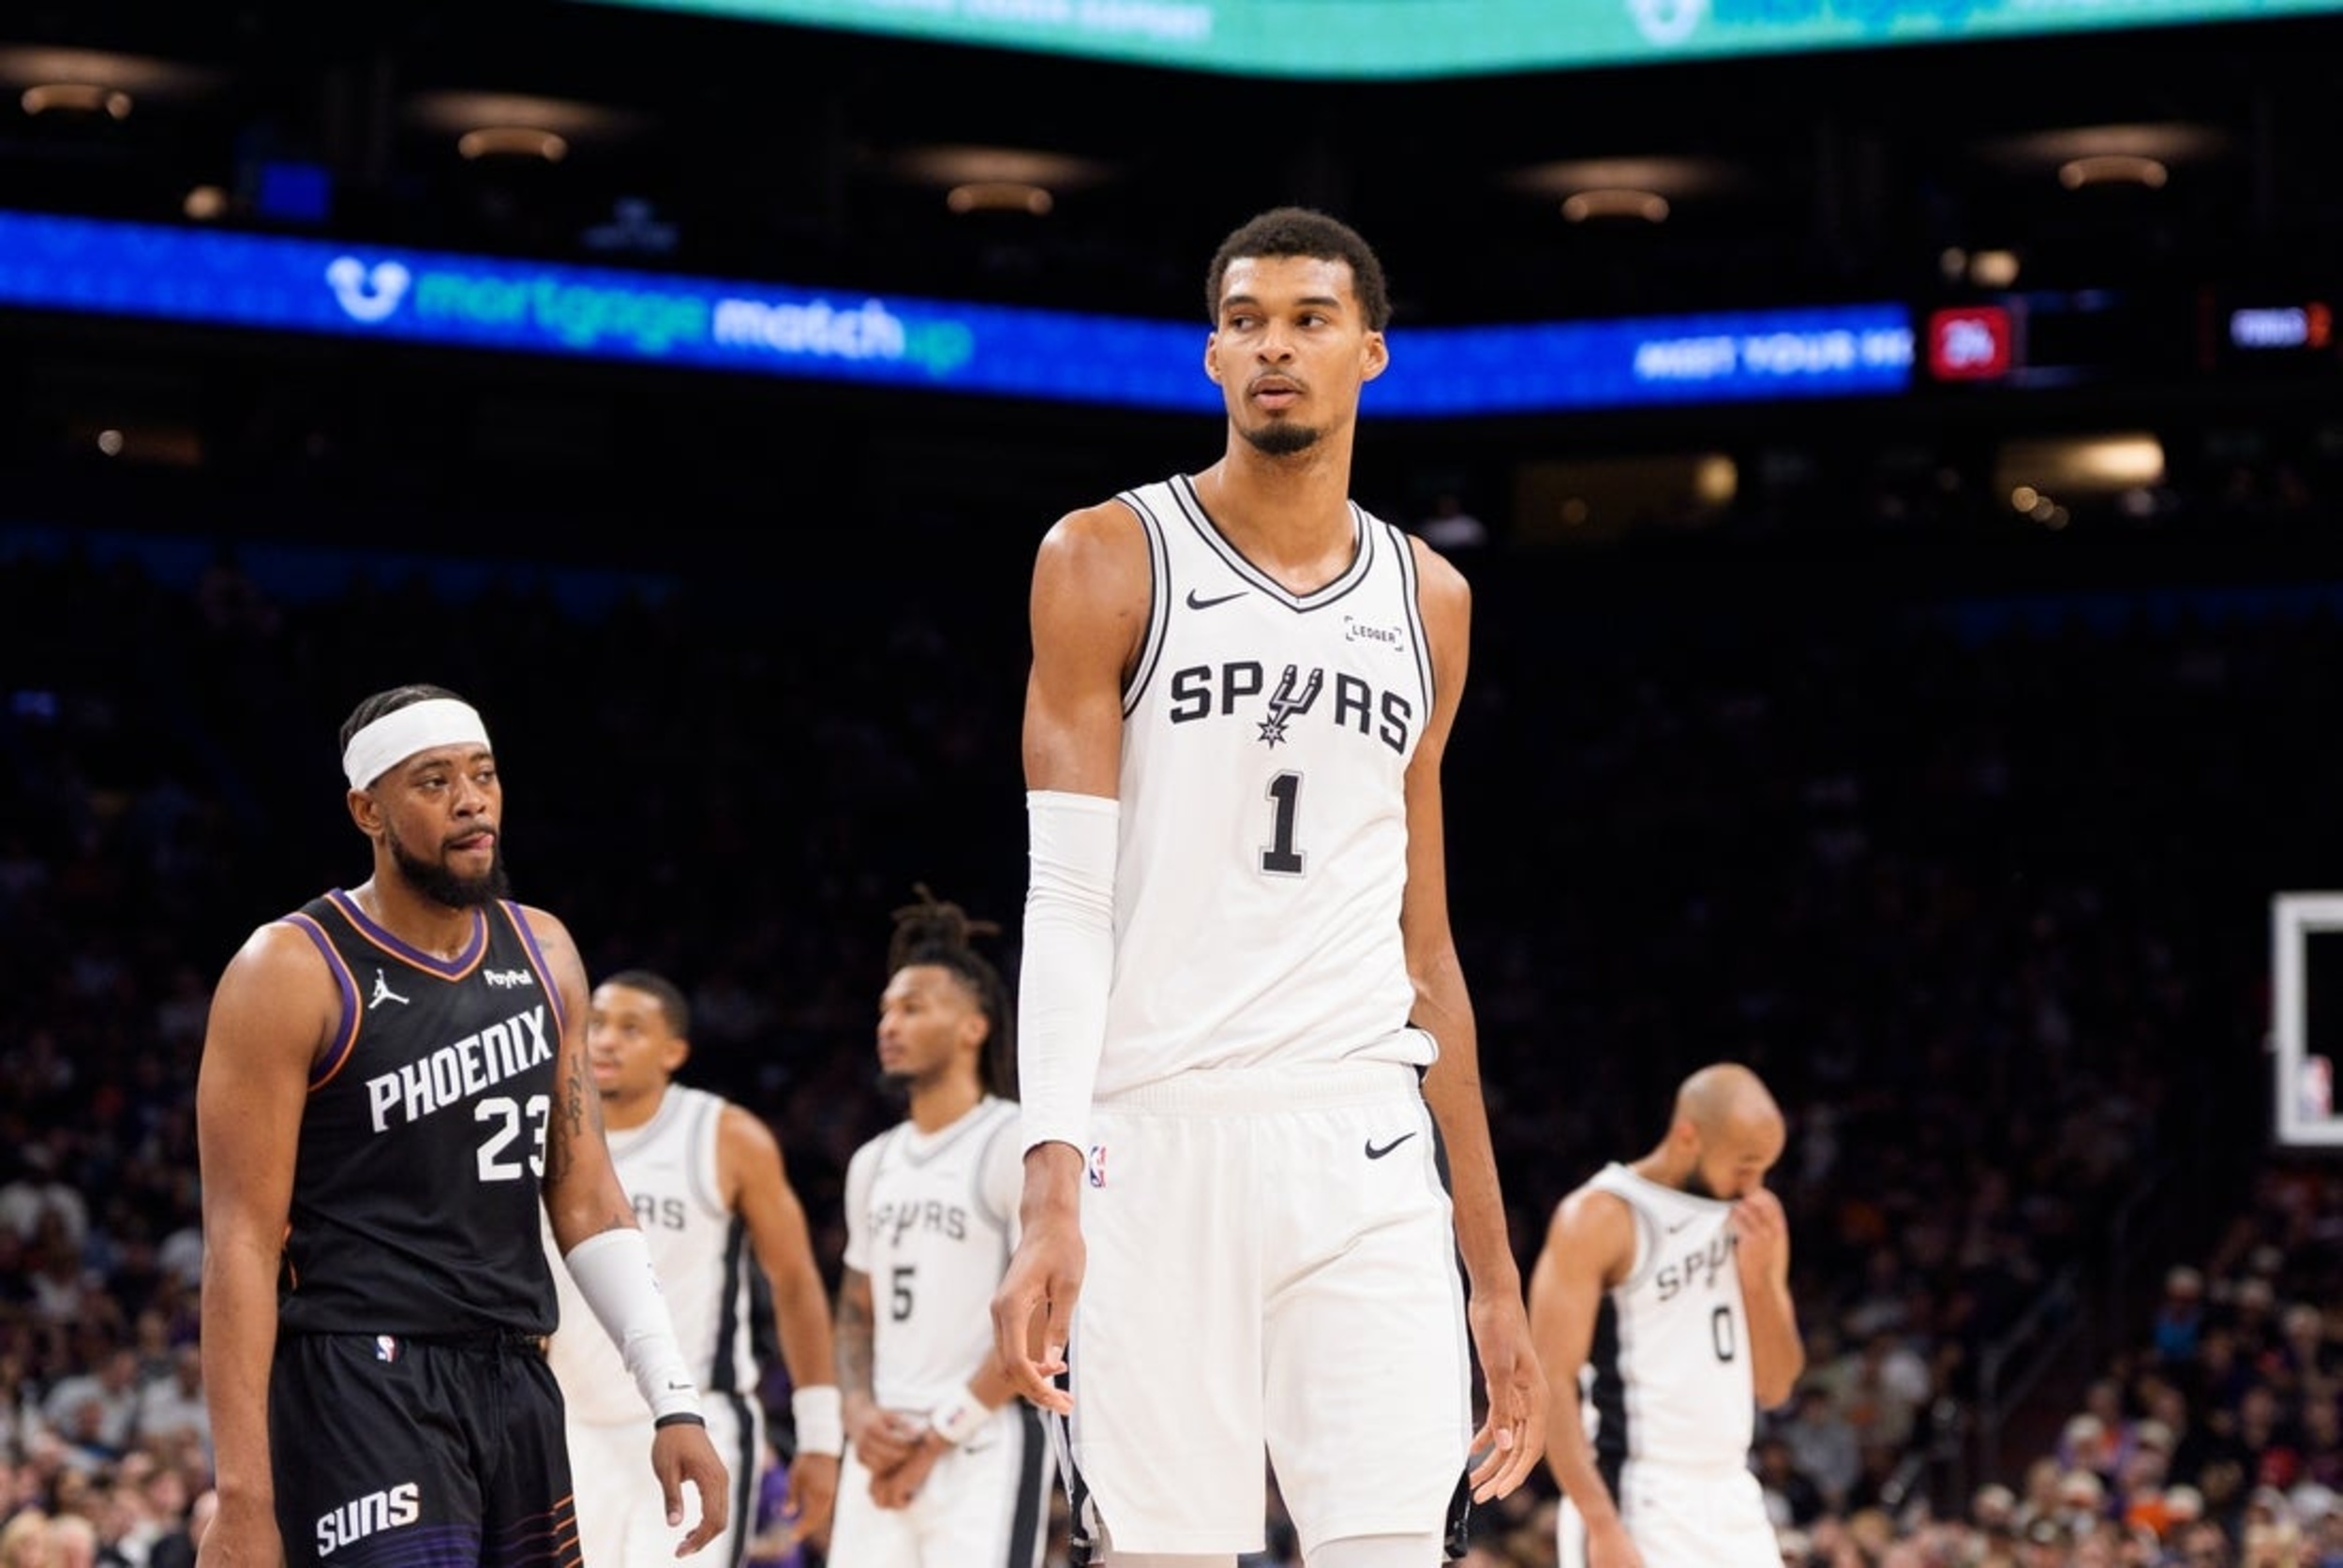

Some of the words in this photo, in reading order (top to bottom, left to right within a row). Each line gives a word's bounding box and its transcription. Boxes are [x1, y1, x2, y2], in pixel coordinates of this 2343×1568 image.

[1351, 623, 1396, 645] LEDGER
[1170, 661, 1412, 755] SPURS
[1261, 771, 1305, 875] 1
[483, 969, 533, 990] PayPal
[366, 1005, 552, 1133] PHOENIX
[891, 1264, 917, 1323] 5
[1711, 1305, 1736, 1363] 0
